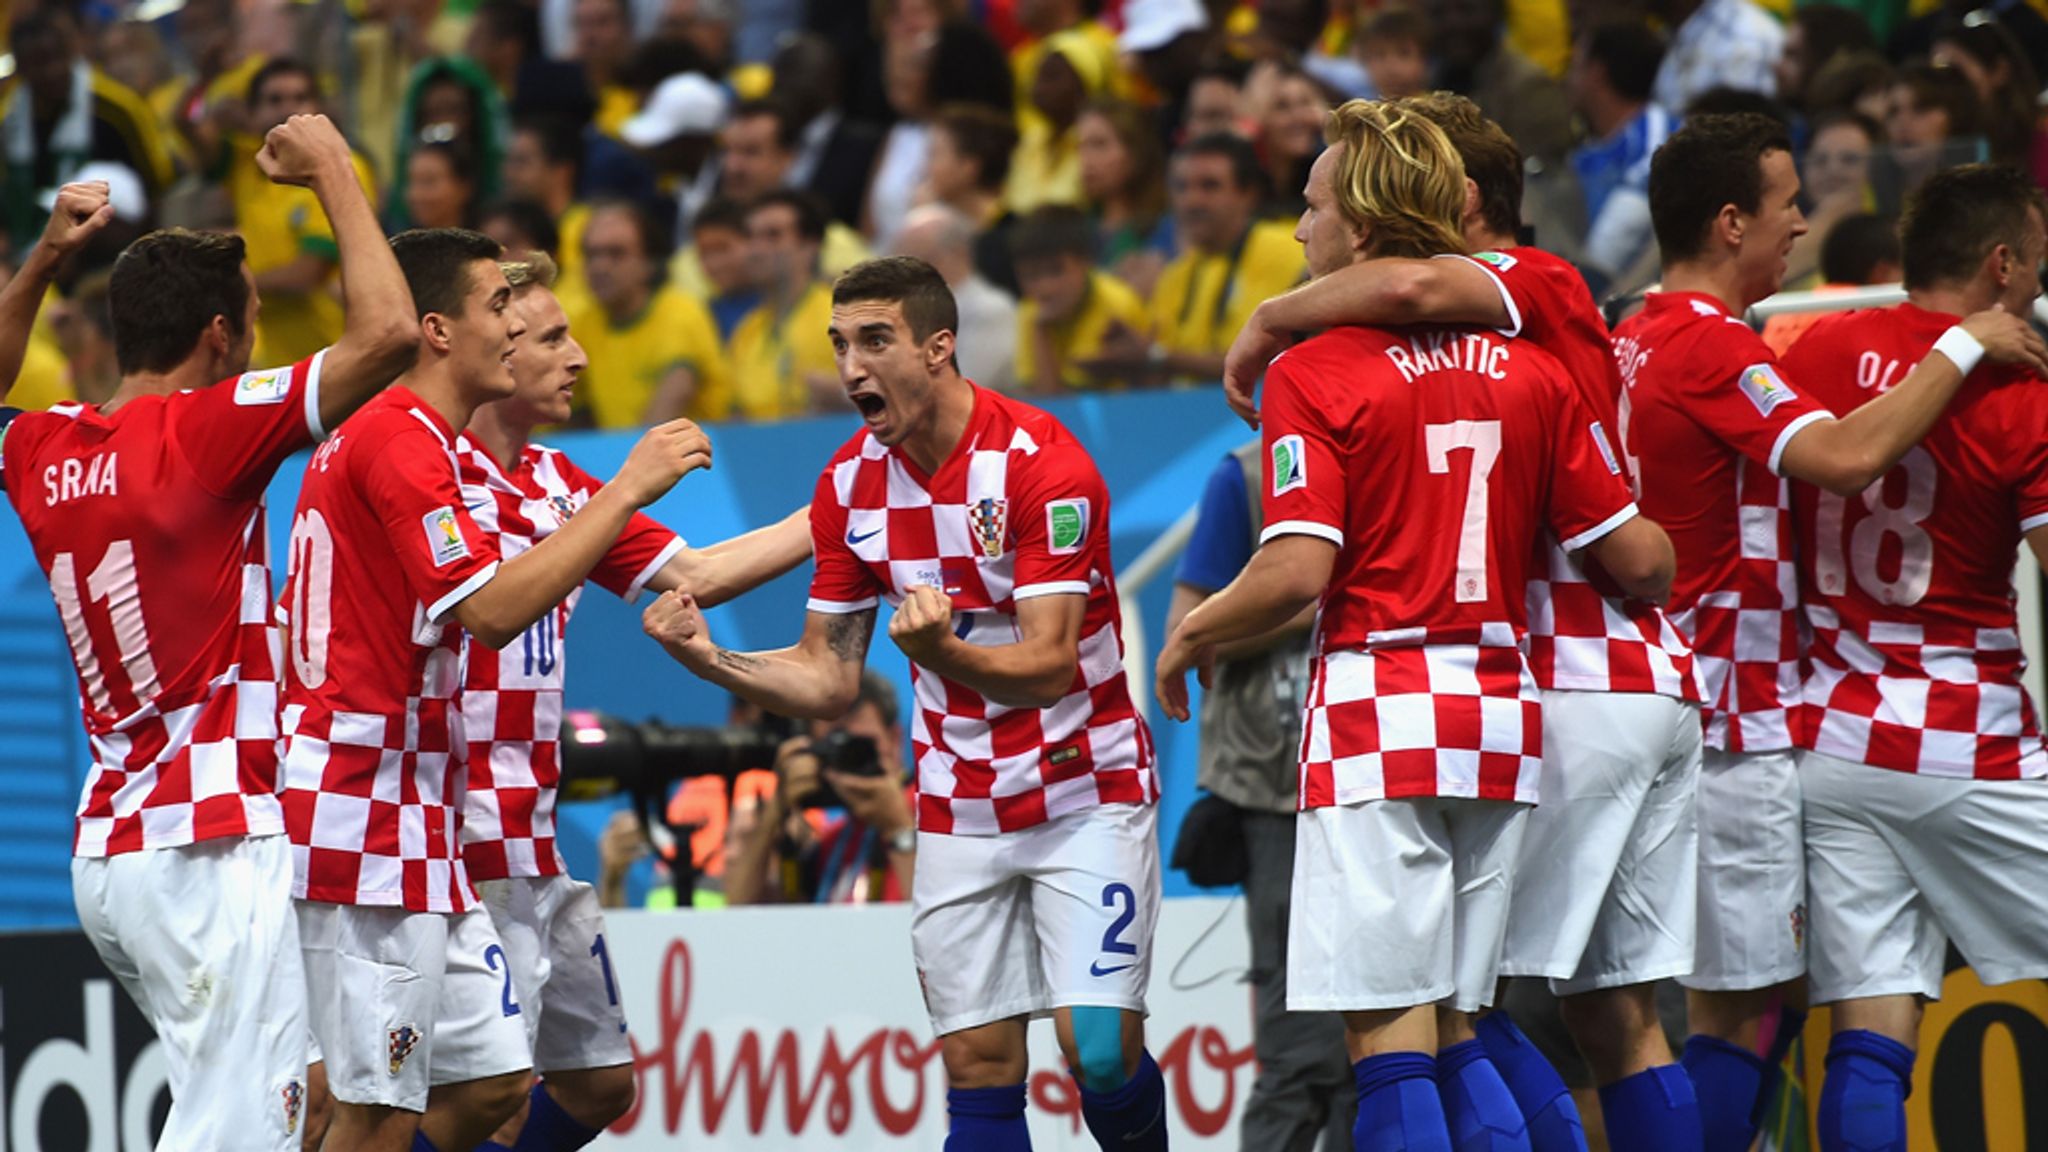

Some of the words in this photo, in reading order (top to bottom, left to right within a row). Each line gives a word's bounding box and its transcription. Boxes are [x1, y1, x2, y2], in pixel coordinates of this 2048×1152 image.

[1857, 351, 1918, 393] OL
[1425, 420, 1502, 603] 7
[1816, 446, 1937, 607] 18
[50, 540, 163, 720] 11
[1102, 883, 1137, 955] 2
[484, 944, 522, 1017] 2
